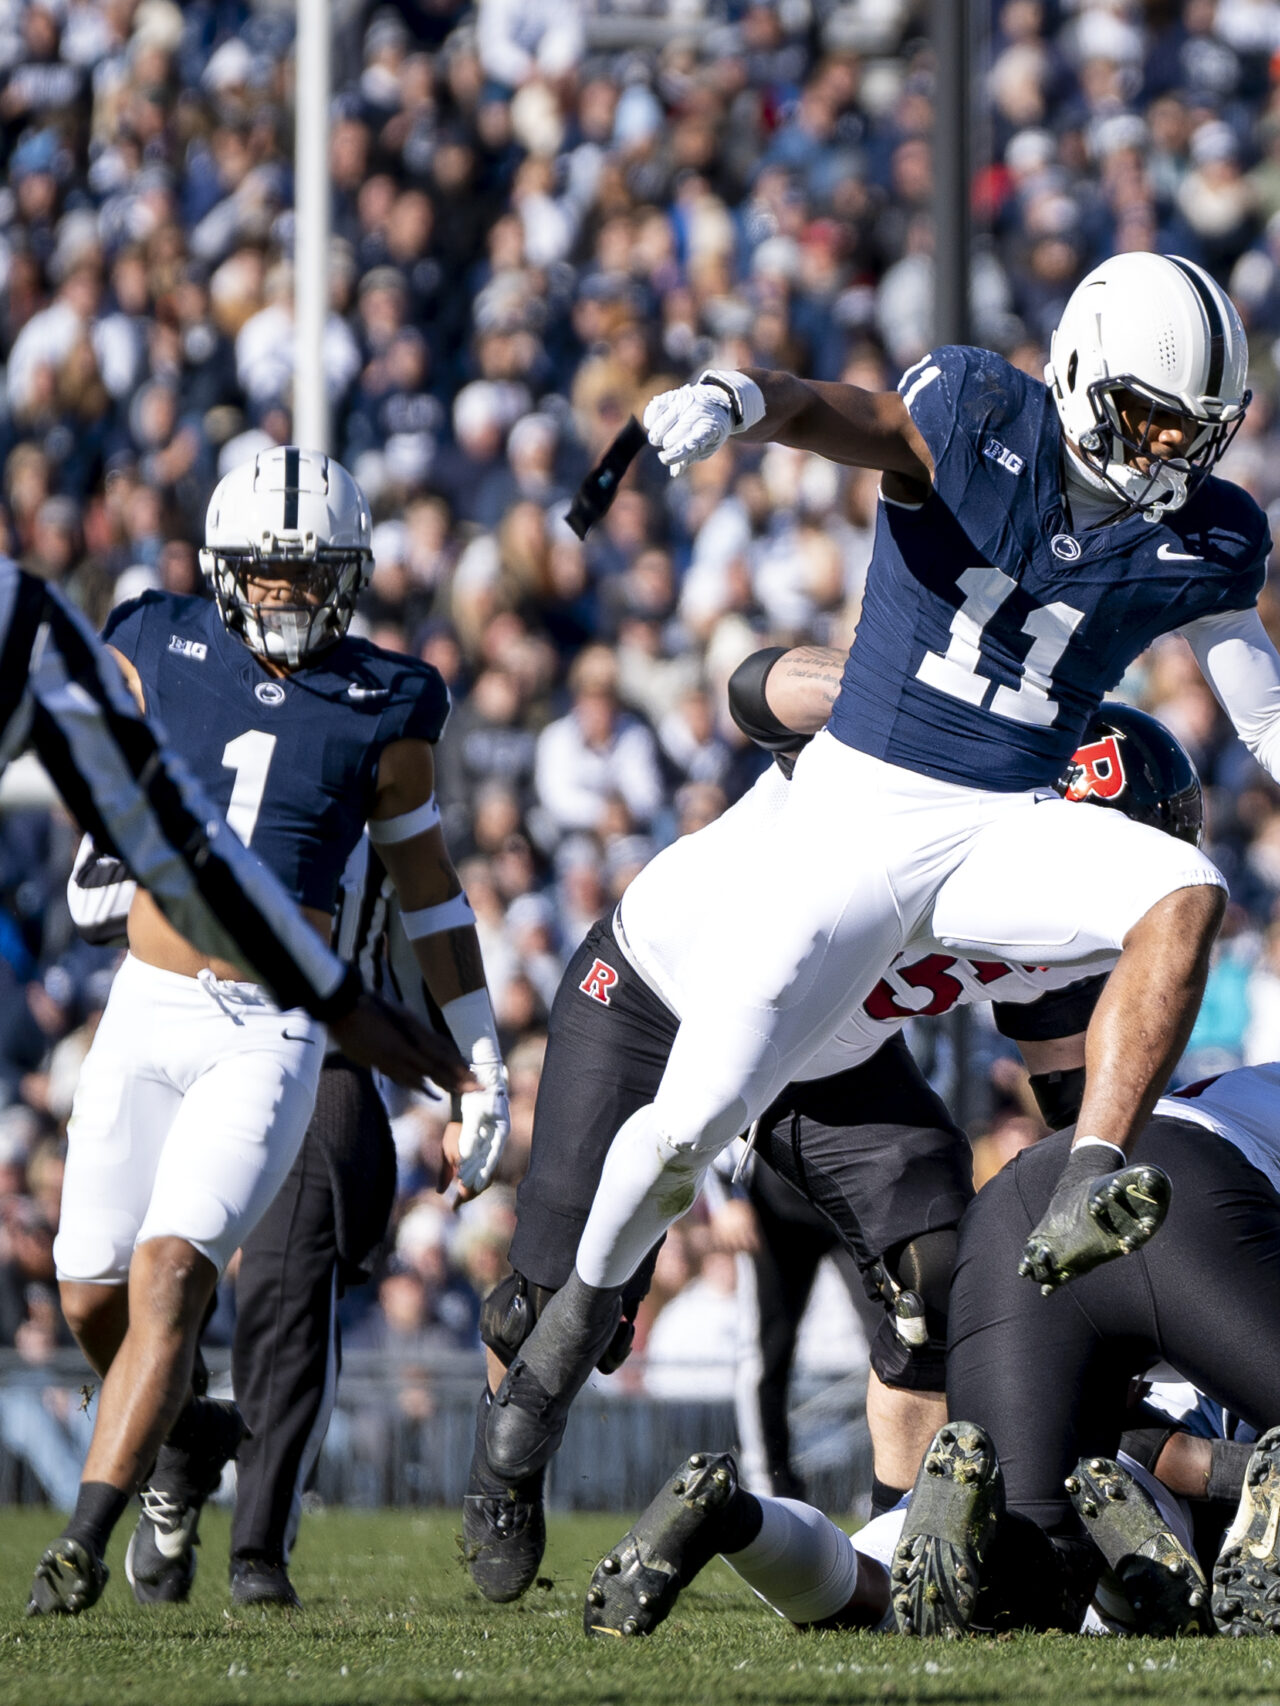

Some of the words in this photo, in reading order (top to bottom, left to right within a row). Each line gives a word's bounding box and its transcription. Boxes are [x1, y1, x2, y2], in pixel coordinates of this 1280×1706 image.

[915, 567, 1086, 727] 11
[221, 729, 277, 849] 1
[1065, 735, 1126, 803] R
[579, 958, 619, 1006] R
